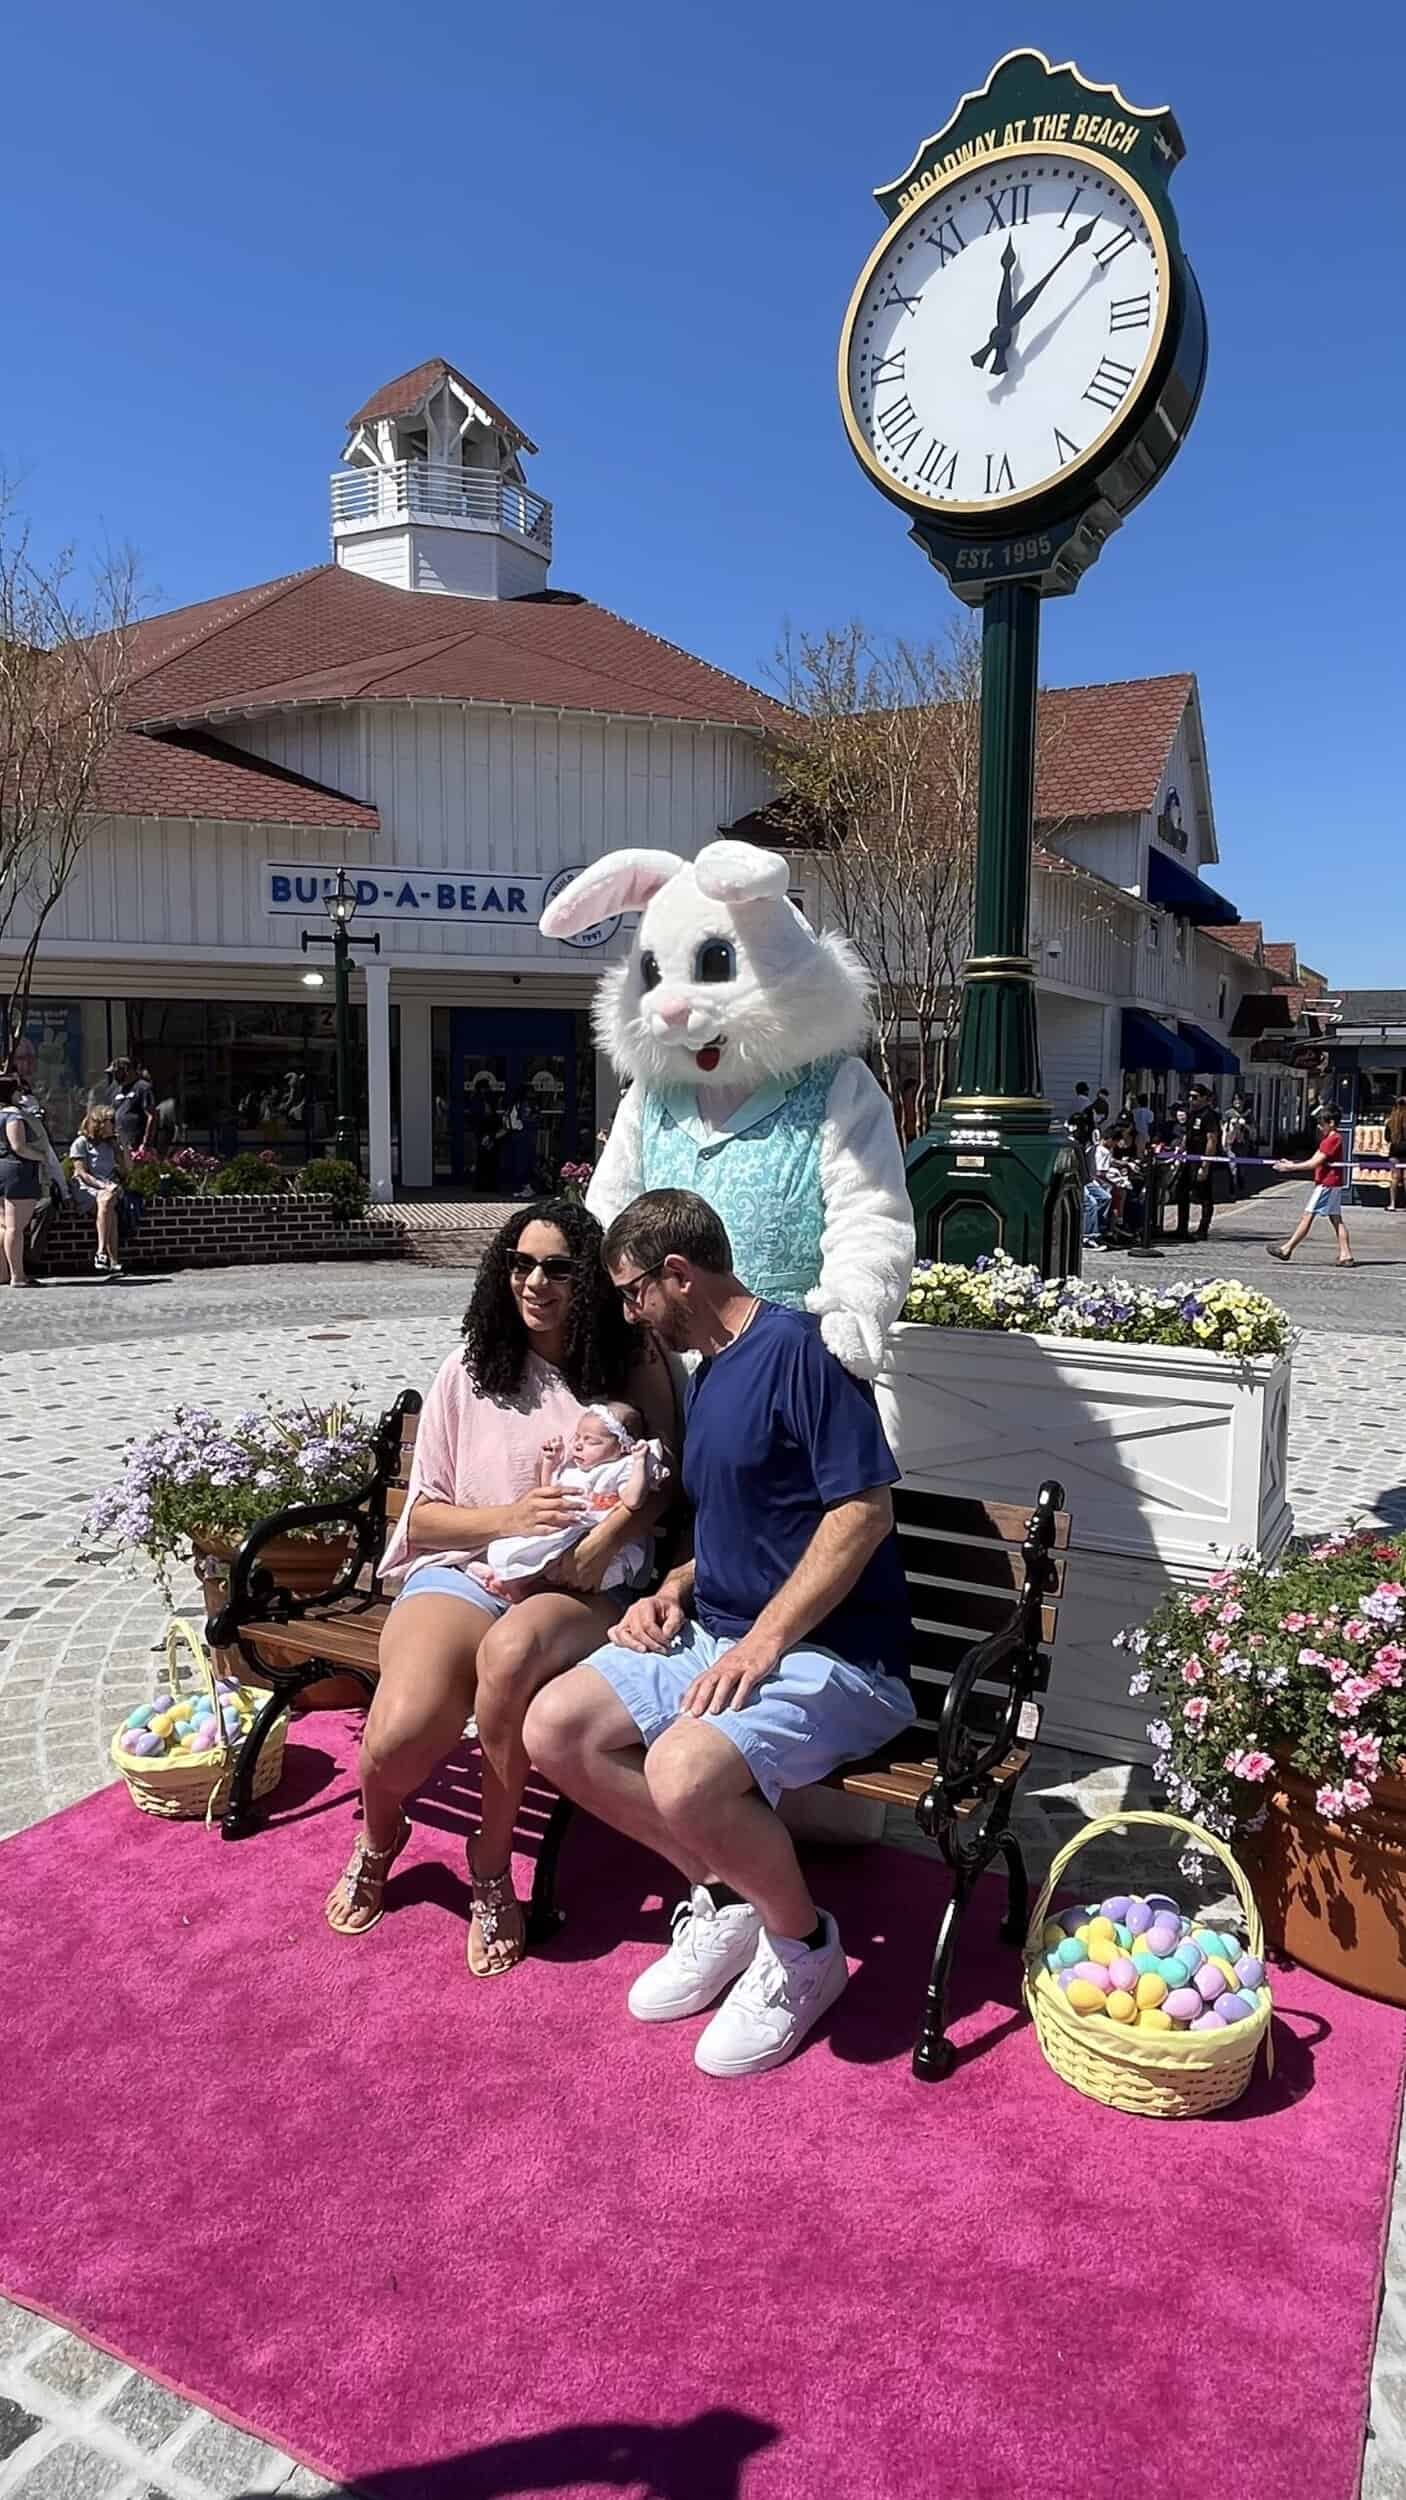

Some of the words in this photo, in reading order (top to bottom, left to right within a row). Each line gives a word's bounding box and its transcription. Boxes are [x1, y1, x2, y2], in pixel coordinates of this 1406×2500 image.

[898, 129, 996, 209] BROADWAY
[1003, 119, 1026, 146] AT
[1032, 113, 1071, 142] THE
[1072, 113, 1140, 154] BEACH
[984, 184, 1032, 234] XII
[1057, 186, 1085, 229] I
[925, 215, 968, 268] XI
[1093, 224, 1137, 271] II
[883, 285, 924, 317] X
[1109, 291, 1151, 335] III
[870, 347, 906, 388] IX
[1080, 355, 1137, 413] IIII
[877, 394, 924, 461] VIII
[1054, 427, 1083, 466] V
[915, 438, 959, 490] VII
[984, 452, 1017, 494] VI
[955, 548, 994, 569] EST.
[1001, 535, 1052, 567] 1995
[271, 875, 528, 913] BUID-A-BEAR
